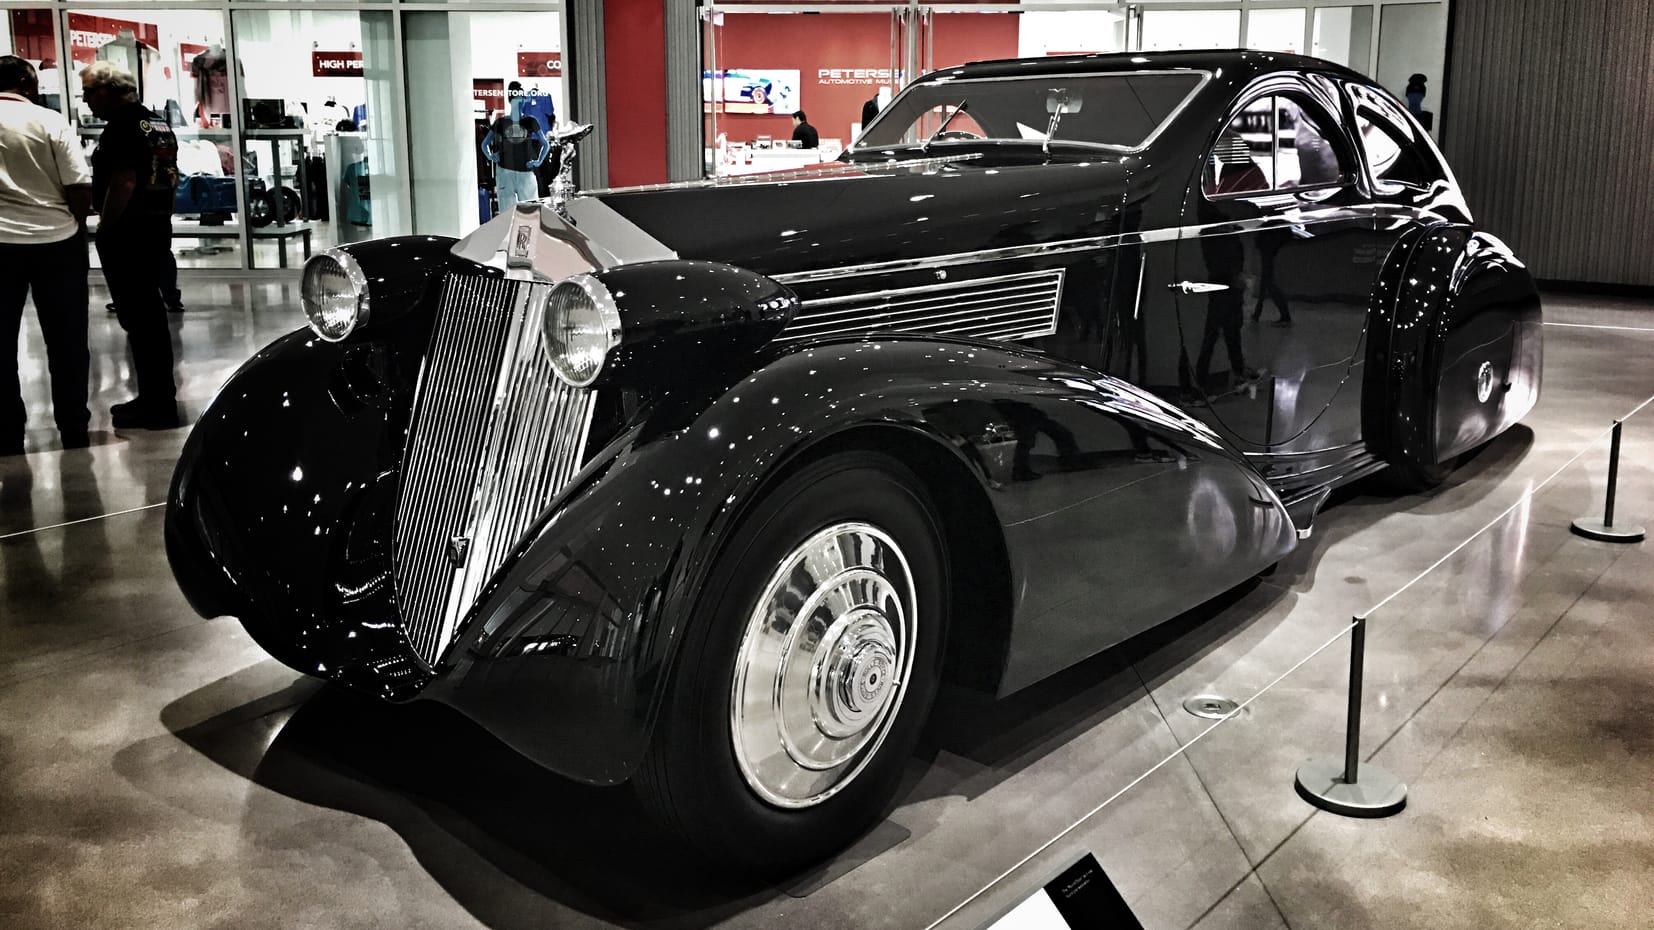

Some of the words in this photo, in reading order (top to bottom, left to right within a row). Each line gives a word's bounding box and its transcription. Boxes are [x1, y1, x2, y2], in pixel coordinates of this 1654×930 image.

[319, 60, 345, 69] HIGH
[547, 60, 561, 69] CO
[818, 69, 900, 78] PETERSE
